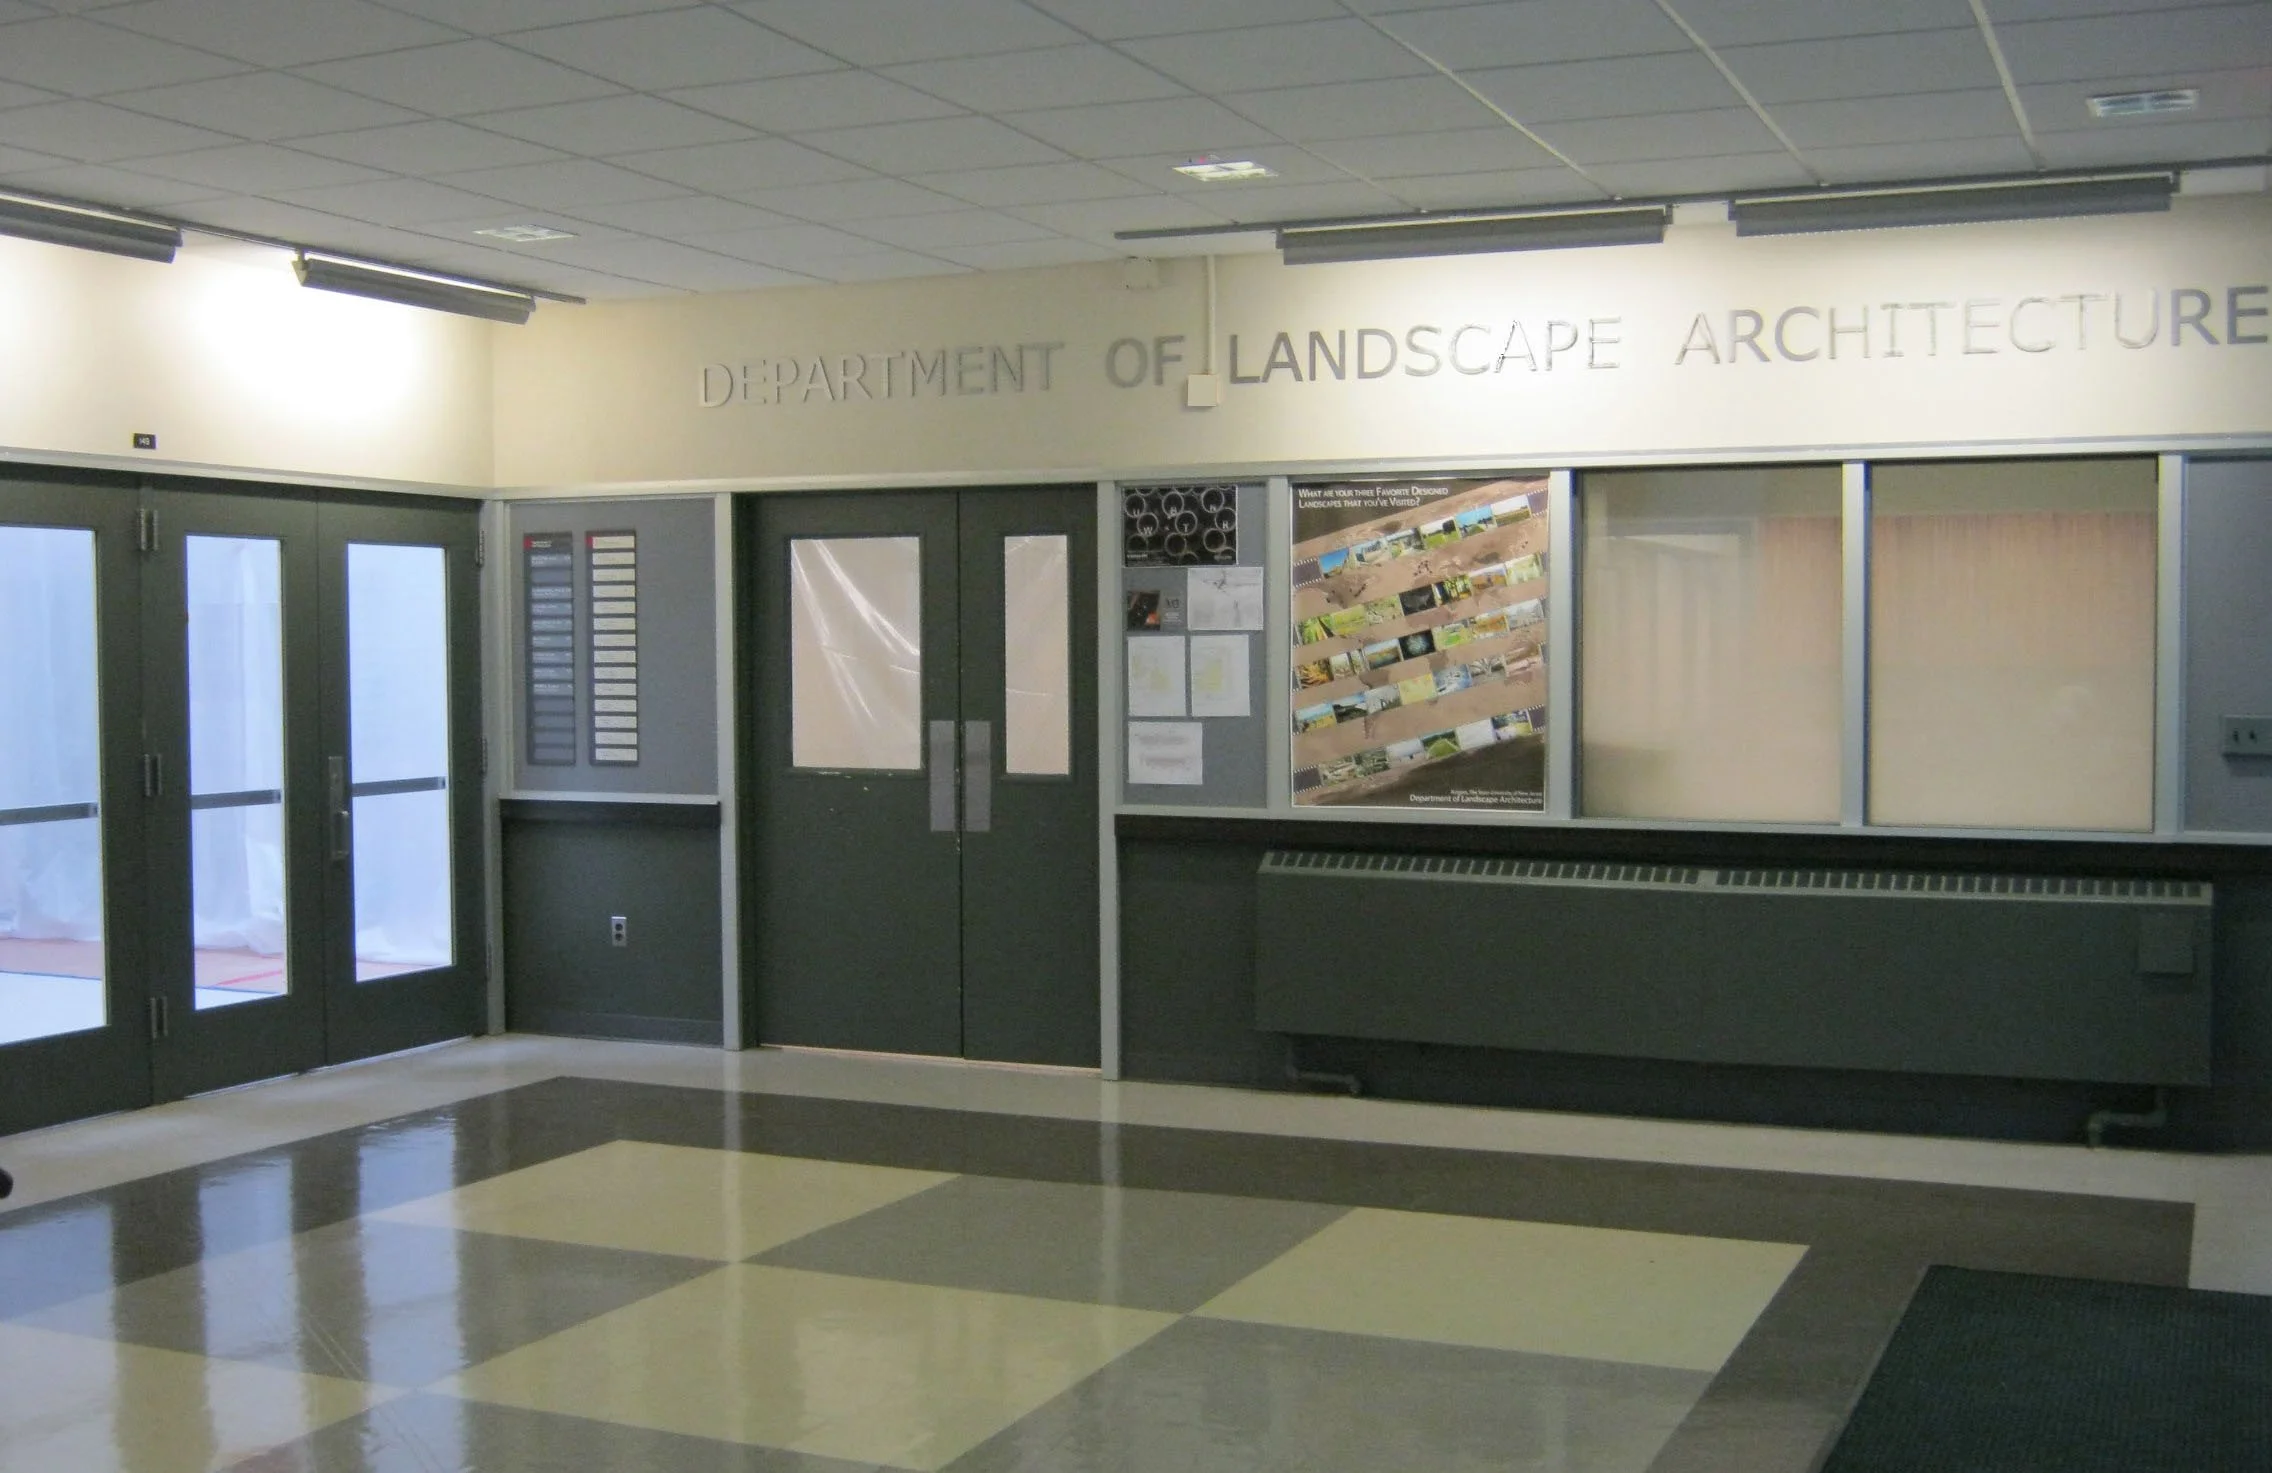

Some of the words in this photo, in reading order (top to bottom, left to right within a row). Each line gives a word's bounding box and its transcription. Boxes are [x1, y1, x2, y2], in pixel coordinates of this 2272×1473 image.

[701, 341, 1066, 408] DEPARTMENT
[1105, 335, 1186, 390] OF
[1229, 318, 1621, 386] LANDSCAPE
[1675, 285, 2271, 365] ARCHITECTURE
